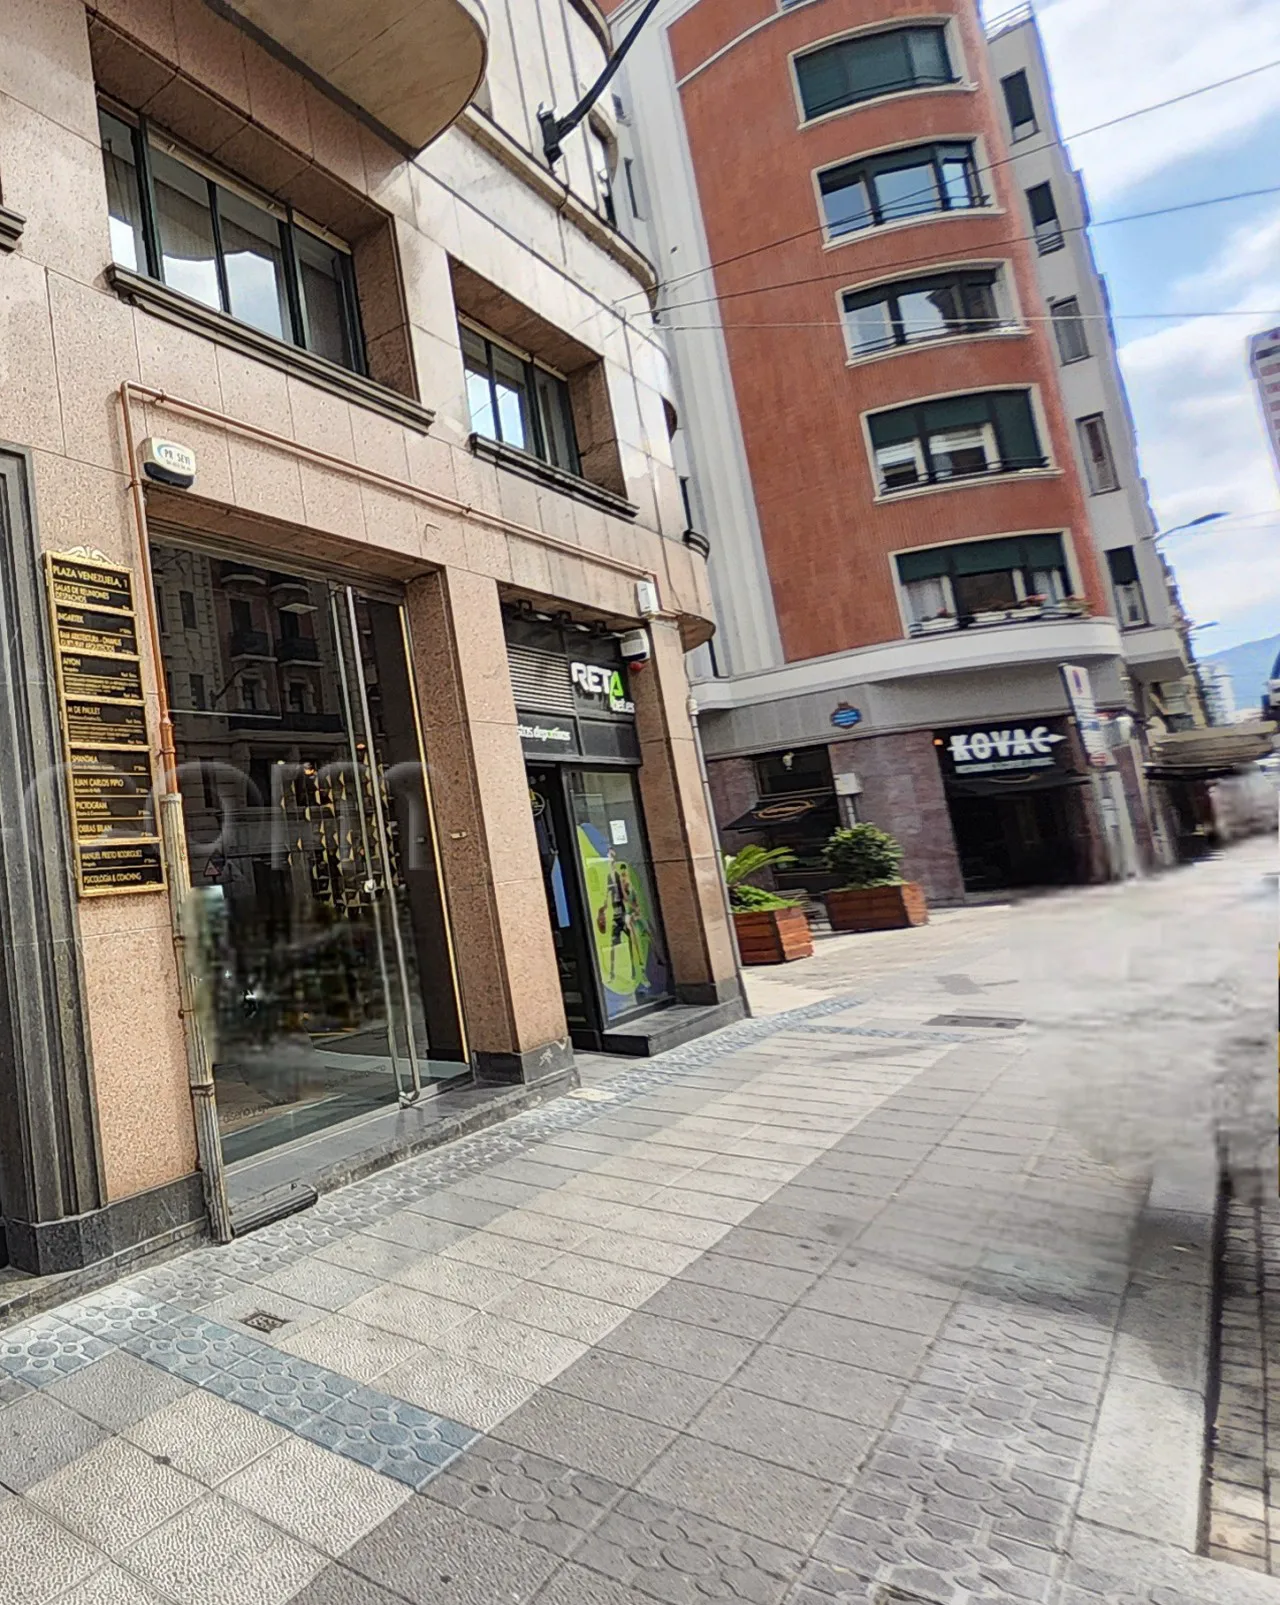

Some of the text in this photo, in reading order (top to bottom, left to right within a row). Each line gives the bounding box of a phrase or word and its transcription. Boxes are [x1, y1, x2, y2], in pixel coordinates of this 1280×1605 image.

[52, 565, 76, 580] PLAZA
[54, 583, 71, 593] SALAS
[71, 586, 79, 595] DE
[571, 662, 624, 703] RETA
